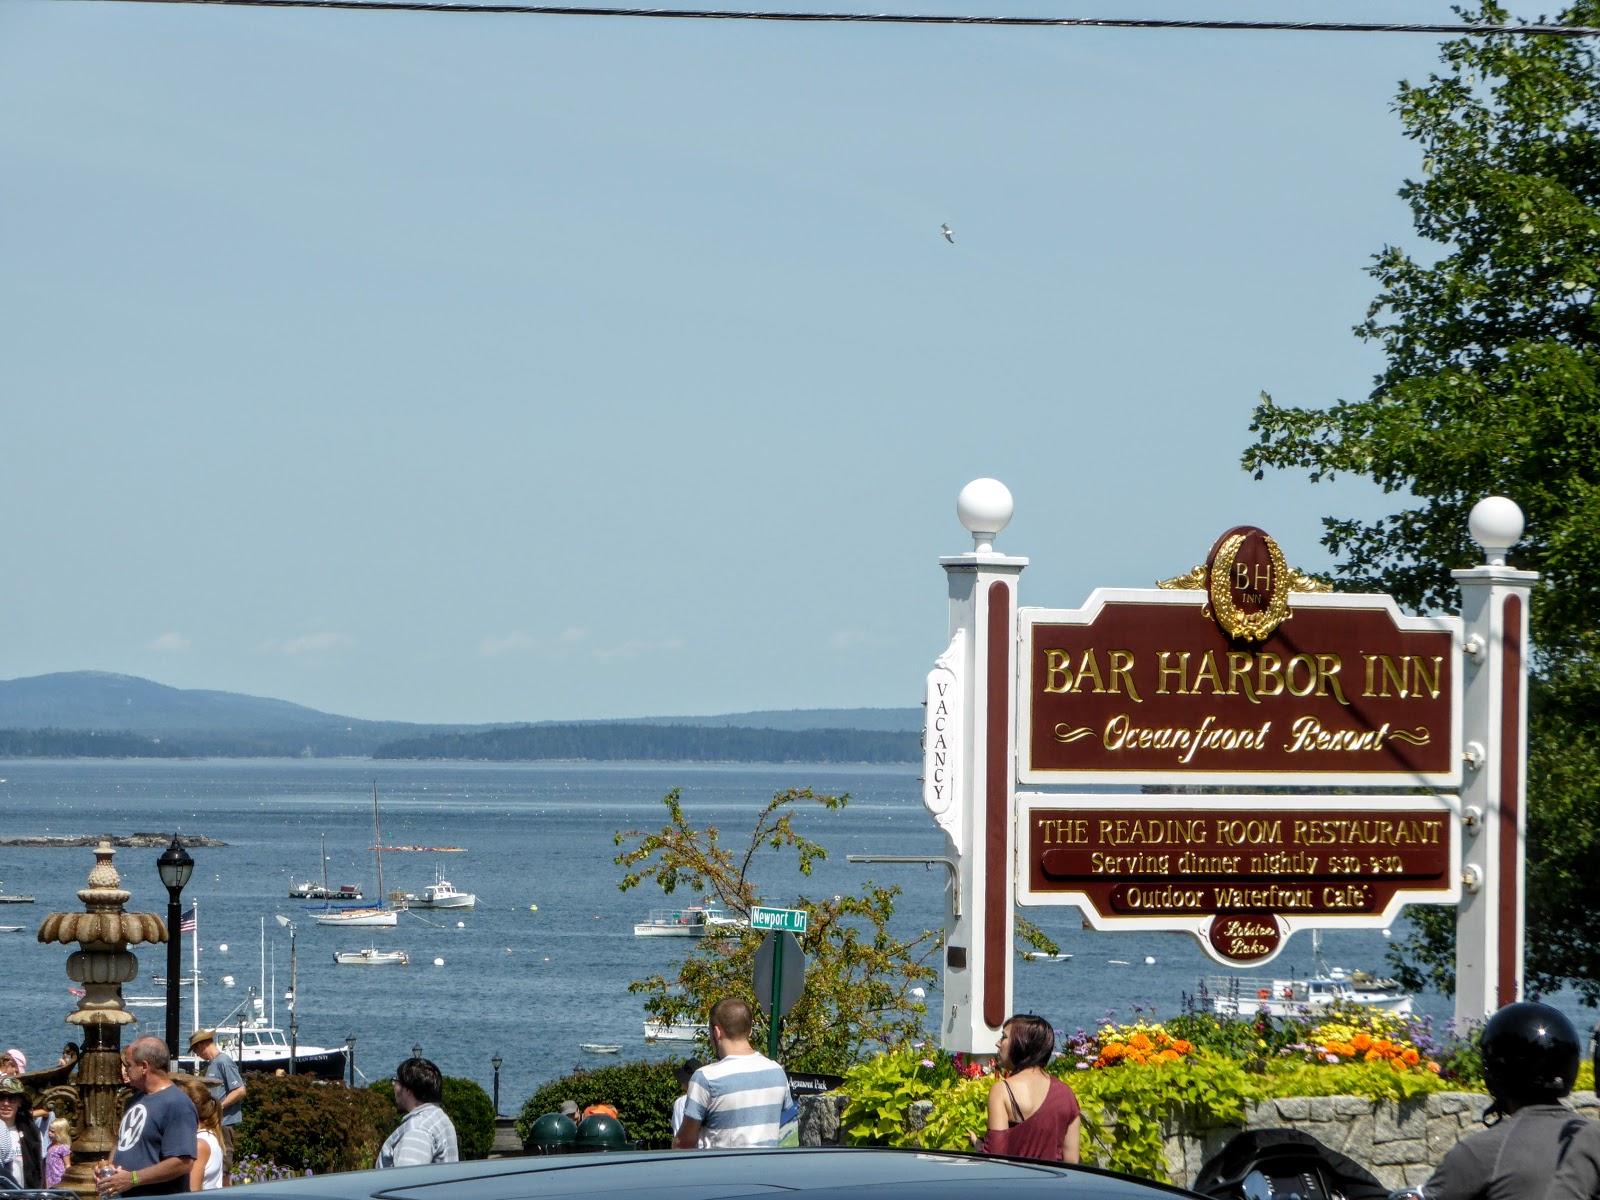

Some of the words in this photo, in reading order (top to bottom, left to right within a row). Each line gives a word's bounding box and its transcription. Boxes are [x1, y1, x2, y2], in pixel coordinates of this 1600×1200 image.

[1235, 562, 1271, 591] BH
[1242, 593, 1262, 604] INN
[1043, 647, 1144, 703] BAR
[1155, 650, 1350, 706] HARBOR
[1361, 655, 1444, 700] INN
[933, 683, 948, 800] VACANCY
[1103, 713, 1272, 764] Oceanfront
[1283, 714, 1391, 753] Resort
[1038, 819, 1089, 845] THE
[1098, 819, 1207, 847] READING
[1215, 819, 1284, 846] ROOM
[1293, 819, 1443, 847] RESTAURANT
[1091, 851, 1170, 875] Serving
[1178, 851, 1241, 875] dinner
[1250, 851, 1319, 875] nightly
[1126, 884, 1205, 908] Outdoor
[1213, 884, 1314, 908] Waterfront
[753, 908, 788, 928] Newport
[794, 911, 804, 928] Dr
